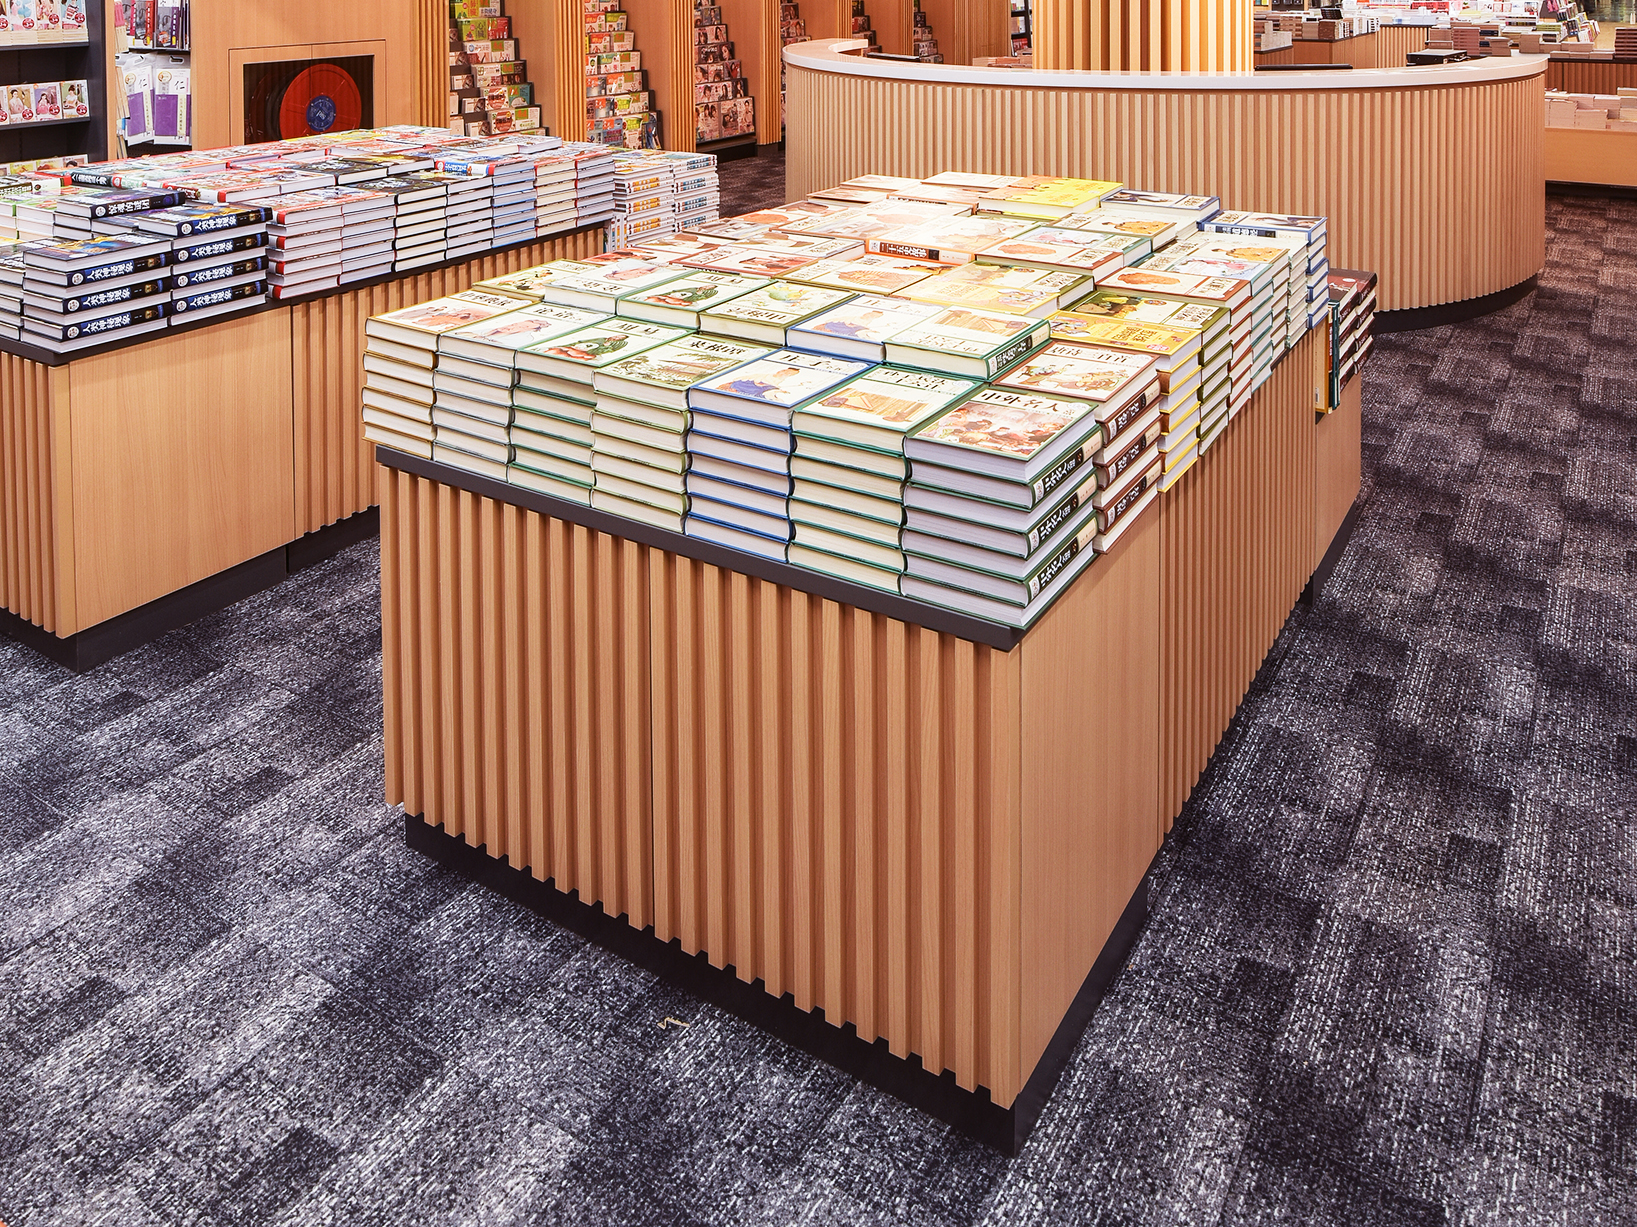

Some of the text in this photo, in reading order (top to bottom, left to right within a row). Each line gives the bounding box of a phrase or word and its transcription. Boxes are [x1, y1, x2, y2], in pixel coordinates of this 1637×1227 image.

[195, 214, 237, 232] 人类神秘现象
[192, 241, 233, 258] 人类神秘现象
[87, 261, 134, 280] 人类神秘现象
[191, 265, 233, 283] 人类神秘现象
[83, 287, 131, 307] 人类神秘现象
[190, 290, 232, 308] 人类神秘现象
[82, 314, 131, 334] 人类神秘现象
[981, 392, 1059, 412] 中外名人
